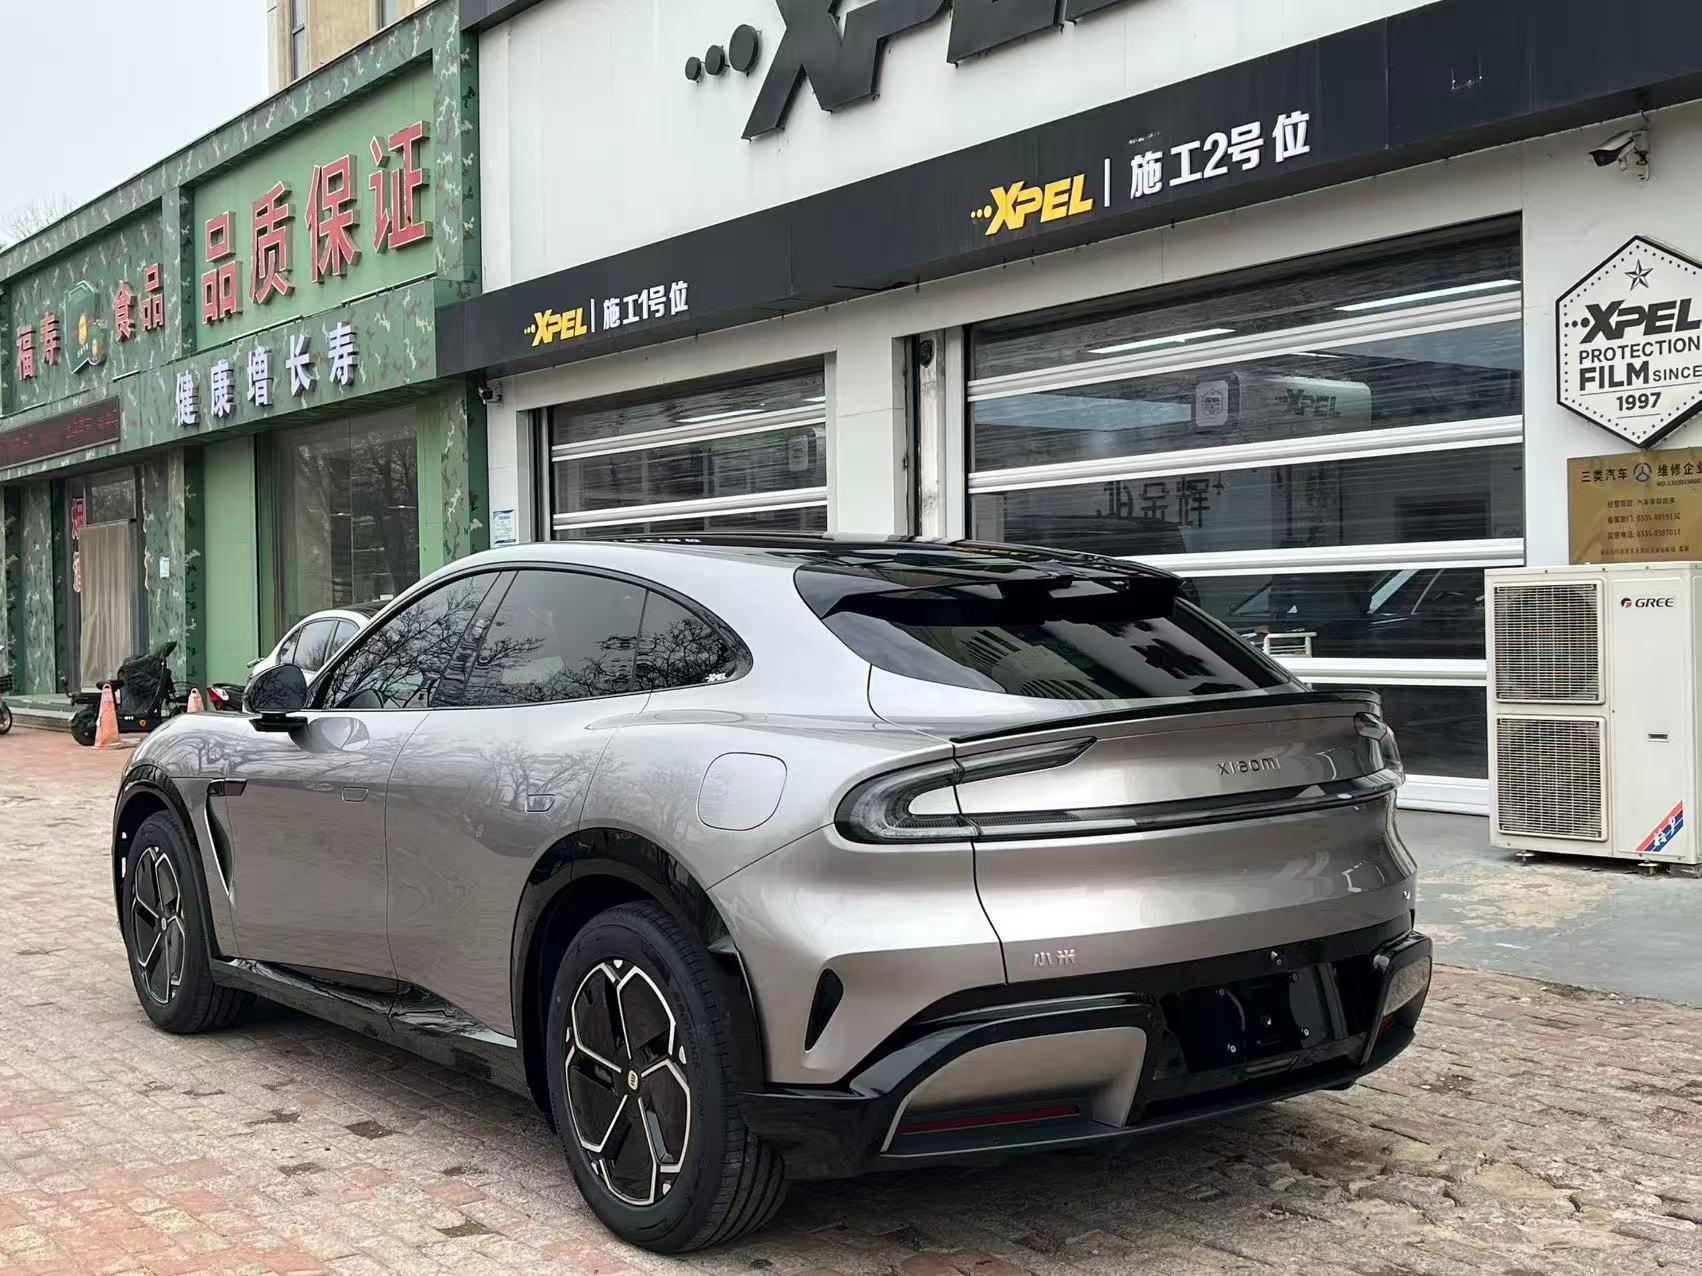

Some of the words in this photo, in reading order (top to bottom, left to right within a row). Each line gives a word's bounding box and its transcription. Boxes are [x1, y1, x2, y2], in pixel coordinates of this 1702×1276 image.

[985, 174, 1093, 235] XPEL
[1130, 110, 1310, 199] 施工2号位
[202, 120, 428, 324] 品质保证
[17, 312, 58, 380] 福寿
[112, 263, 164, 342] 食品
[532, 307, 588, 347] XPEL
[603, 280, 689, 330] 施工1号位
[1580, 298, 1702, 344] XPEL
[1579, 335, 1701, 365] PROTECTION
[176, 321, 357, 426] 健康增长寿
[1580, 361, 1650, 391] FILM
[1653, 365, 1702, 382] SINCE
[1616, 392, 1661, 411] 1997
[1581, 468, 1628, 482] 三类汽车
[1635, 597, 1675, 608] GREE
[1217, 757, 1281, 775] xiaomi
[1032, 949, 1076, 967] 小米
